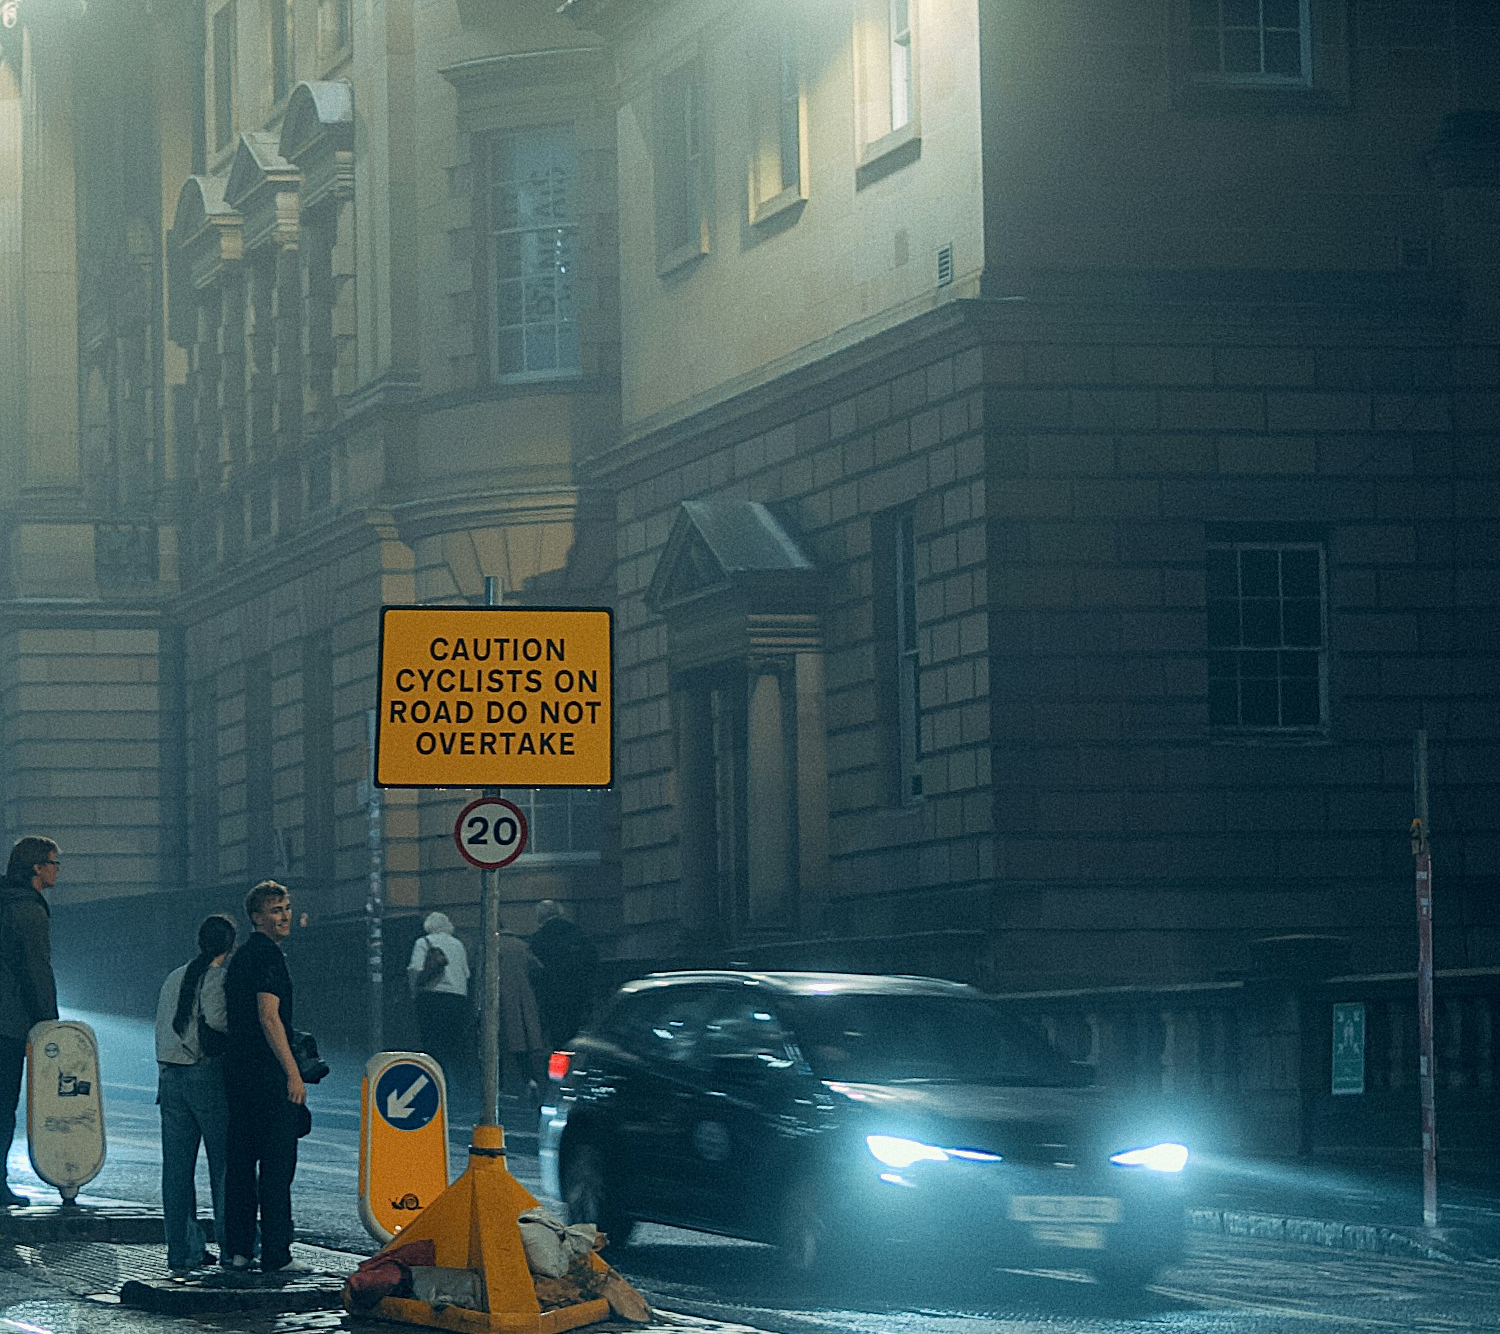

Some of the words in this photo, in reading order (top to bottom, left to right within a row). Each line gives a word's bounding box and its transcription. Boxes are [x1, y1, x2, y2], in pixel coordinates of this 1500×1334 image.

[430, 637, 566, 661] CAUTION
[395, 669, 542, 693] CYCLISTS
[554, 670, 598, 693] ON
[389, 700, 474, 724] ROAD
[486, 701, 528, 725] DO
[540, 701, 602, 725] NOT
[416, 732, 576, 756] OVERTAKE
[467, 816, 517, 846] 20
